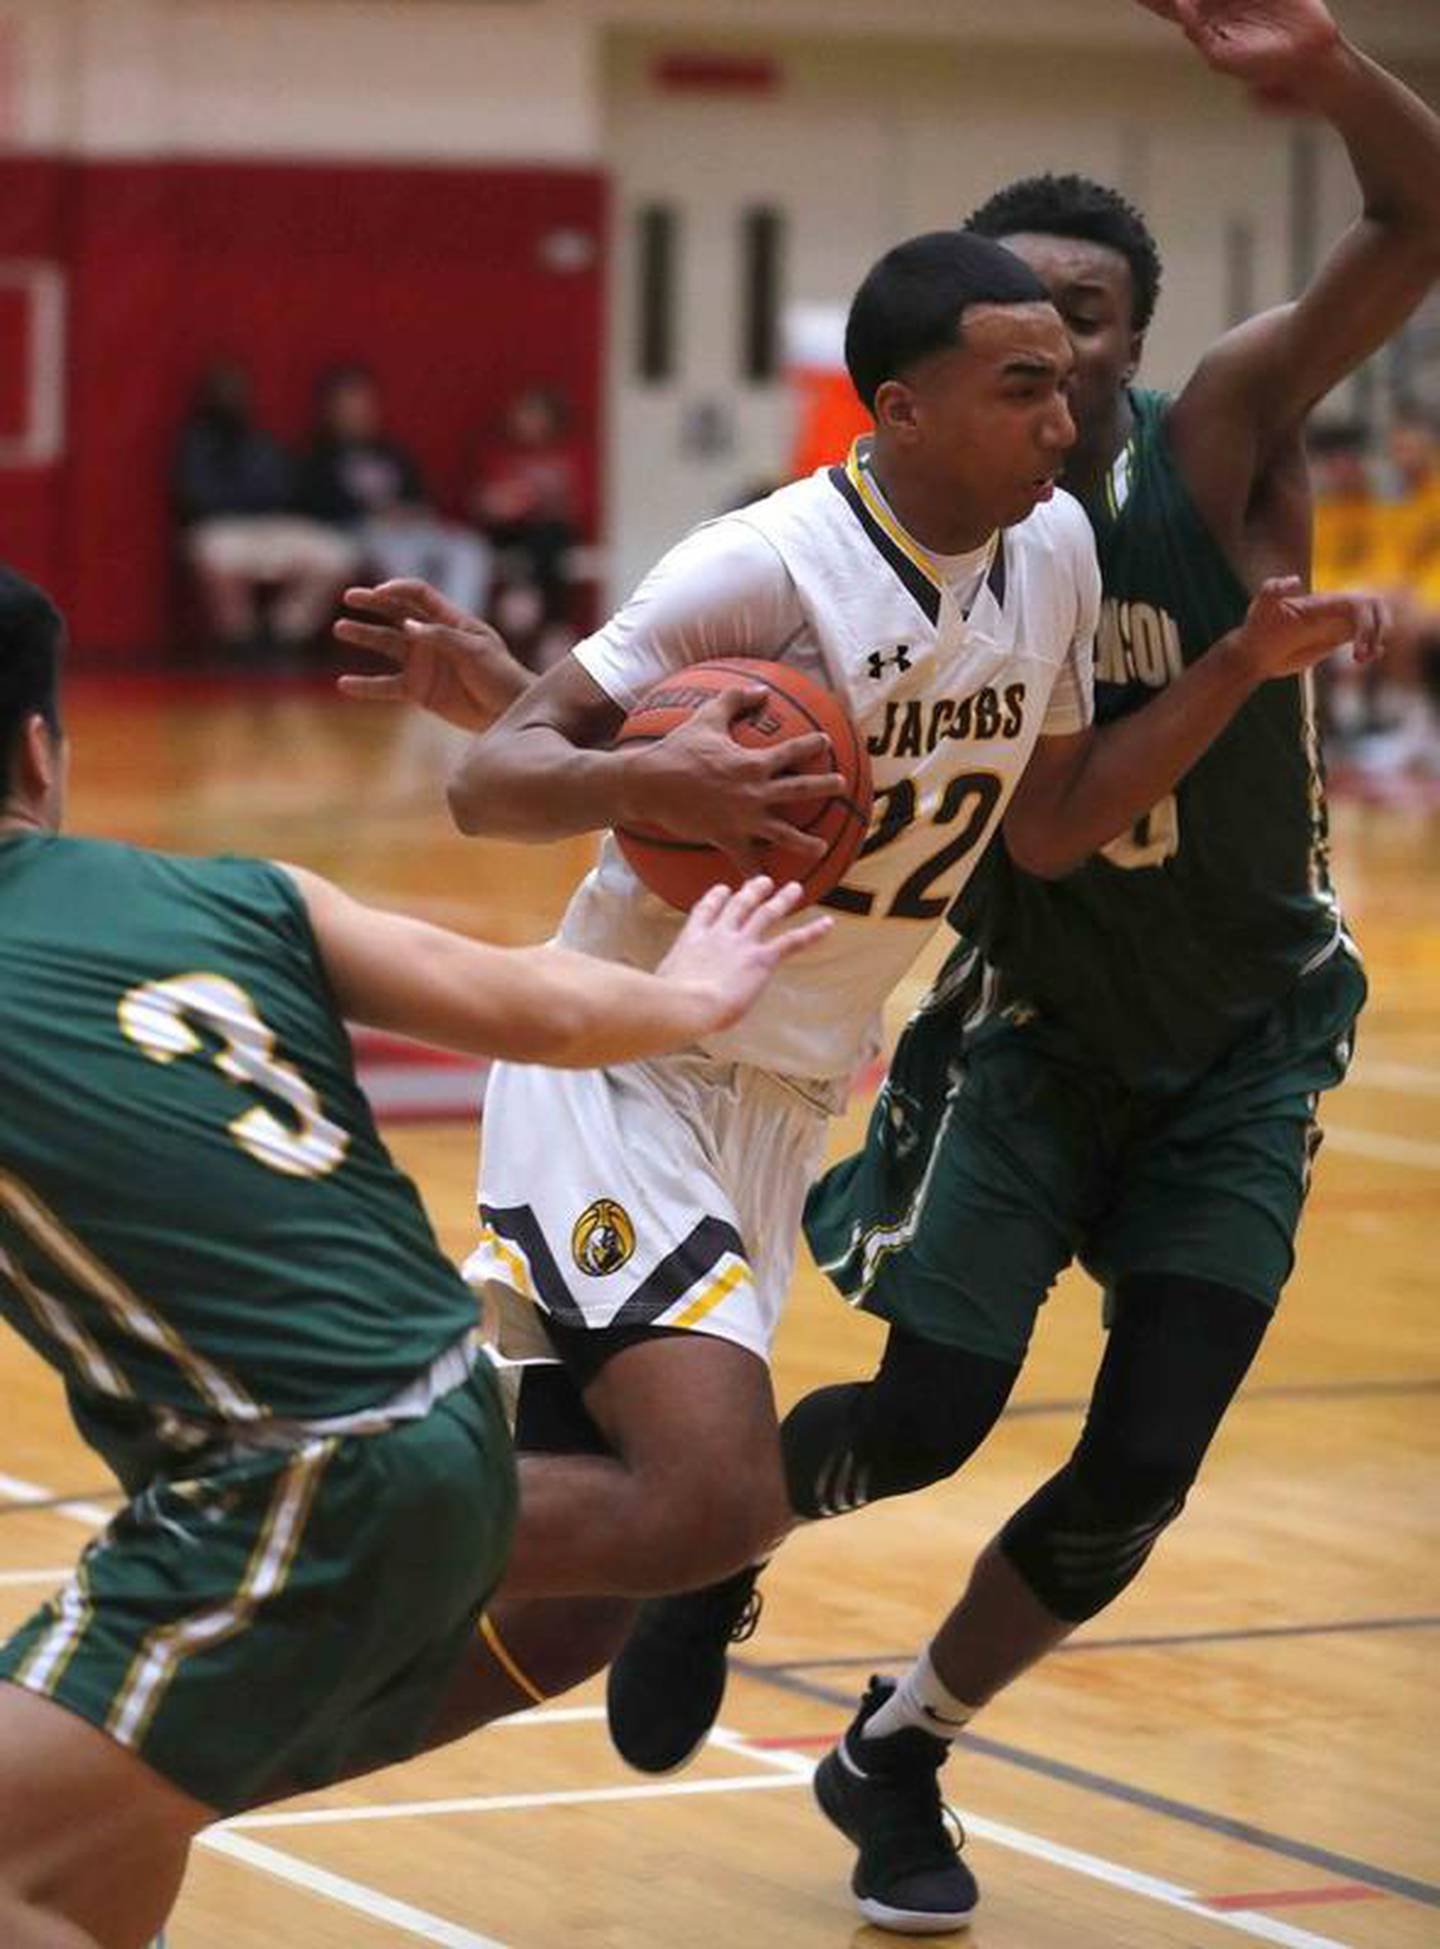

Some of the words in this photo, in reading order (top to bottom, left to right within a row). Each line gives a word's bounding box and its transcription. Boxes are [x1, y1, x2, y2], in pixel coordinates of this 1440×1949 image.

[867, 682, 1025, 757] JACOBS
[816, 772, 1002, 919] 22
[116, 971, 351, 1180] 3
